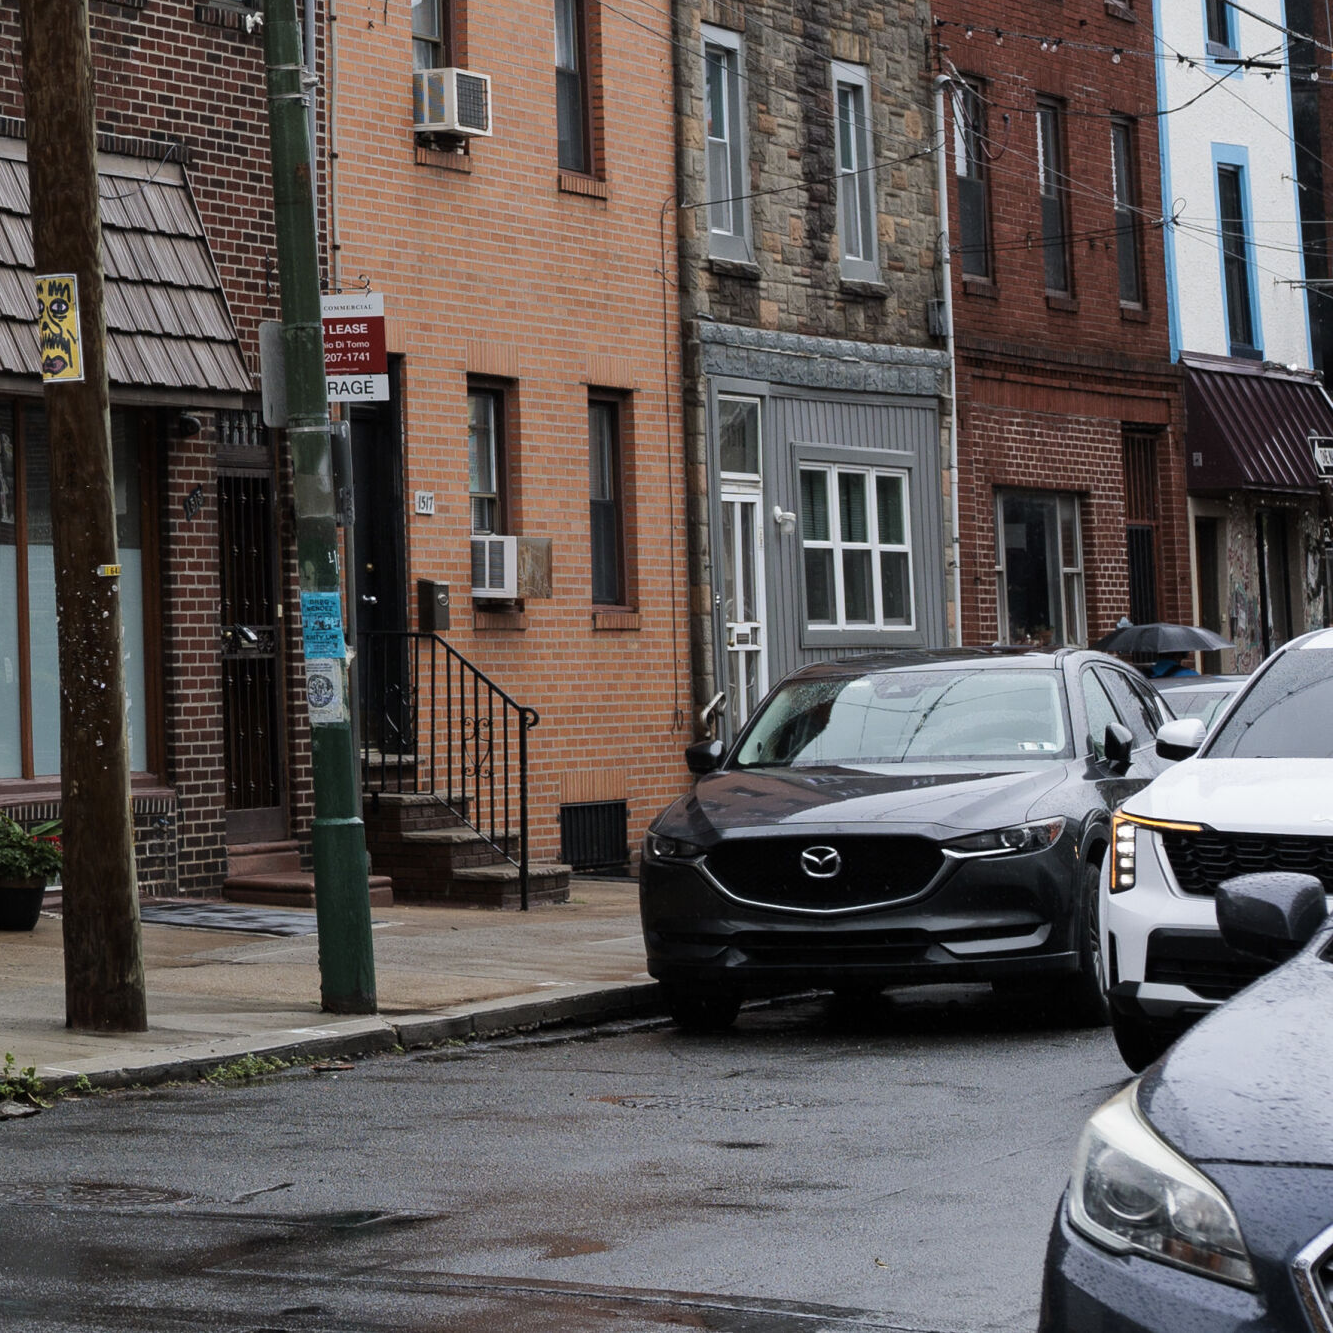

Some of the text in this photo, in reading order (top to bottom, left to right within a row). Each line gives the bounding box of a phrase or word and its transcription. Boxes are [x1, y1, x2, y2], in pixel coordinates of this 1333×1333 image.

[328, 323, 369, 335] LEASE
[335, 340, 345, 349] Di
[346, 340, 370, 349] Tomo
[328, 380, 375, 396] RAGE
[418, 495, 433, 512] 1517
